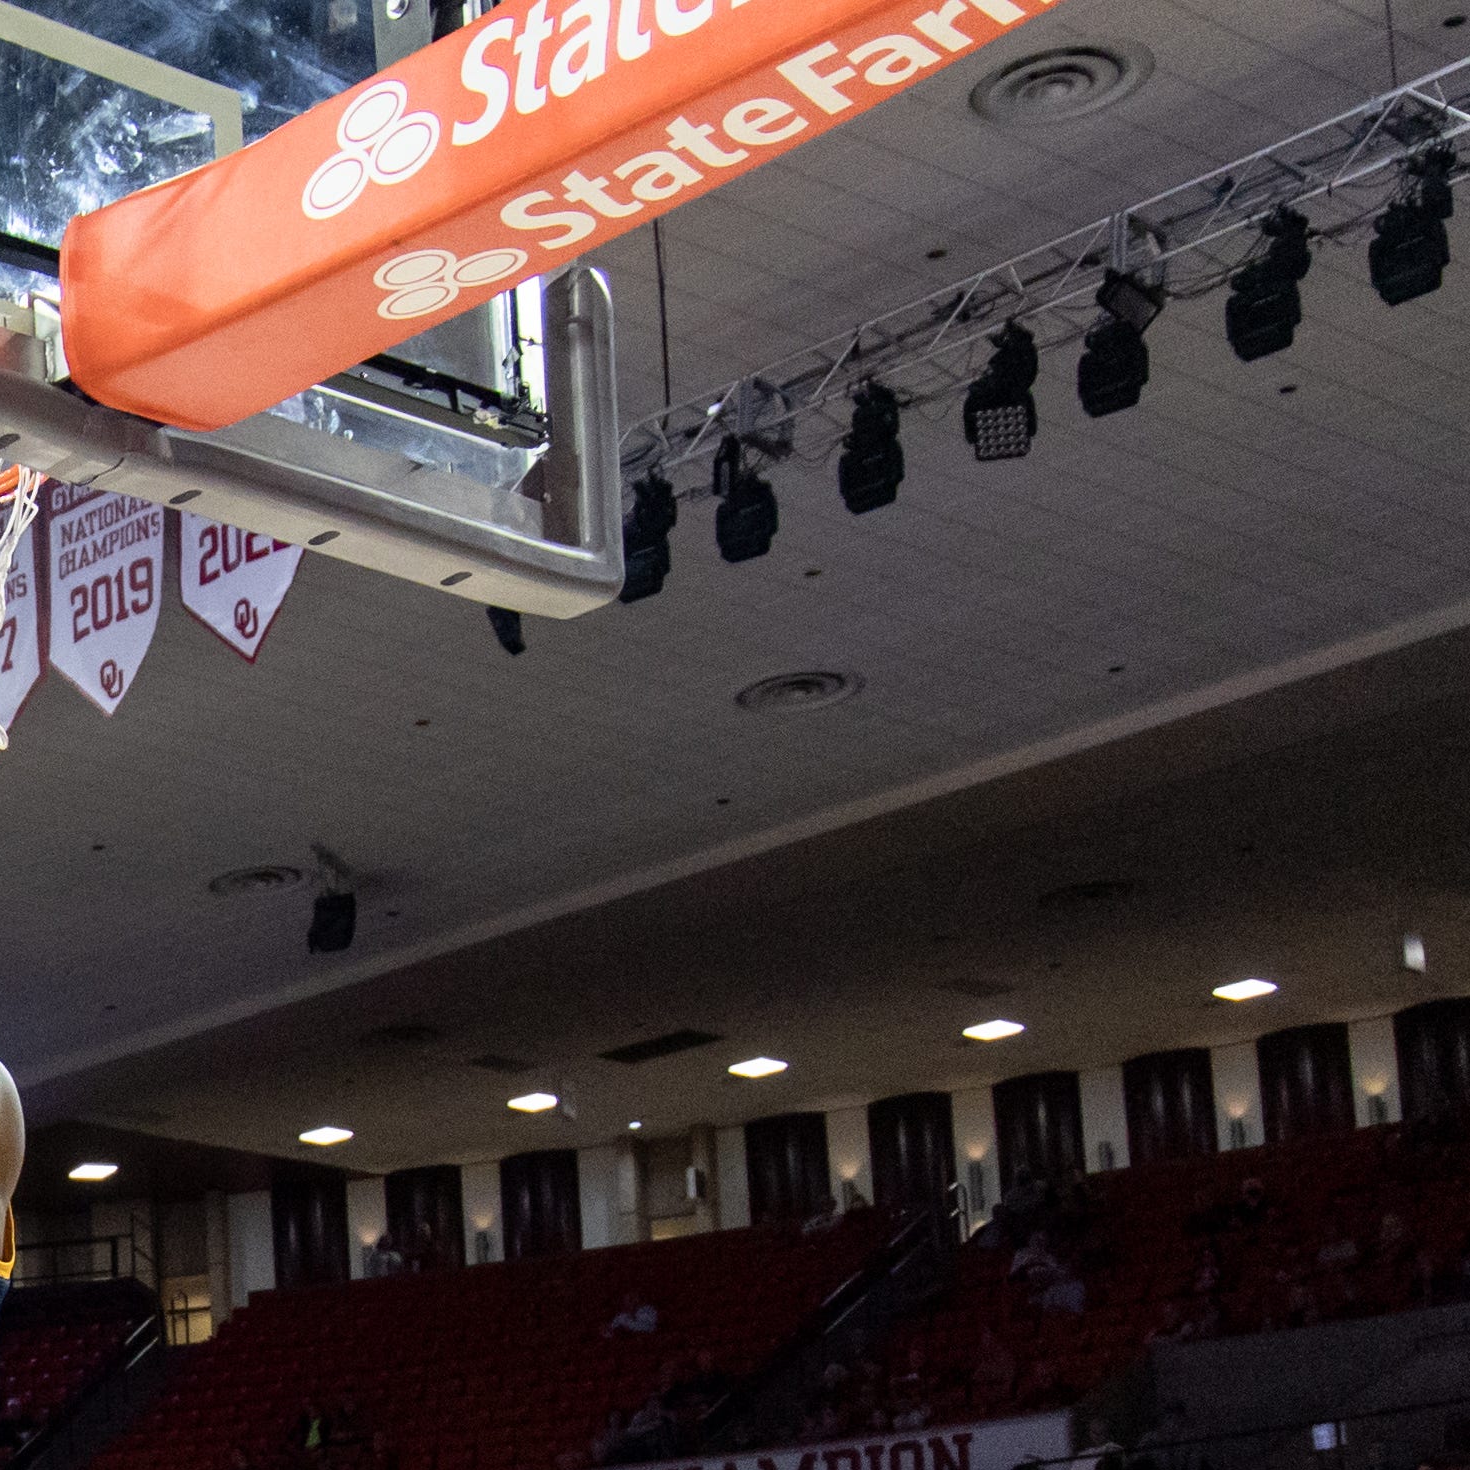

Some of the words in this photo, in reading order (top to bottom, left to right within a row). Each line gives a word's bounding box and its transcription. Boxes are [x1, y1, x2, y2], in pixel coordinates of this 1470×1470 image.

[58, 511, 162, 580] CHAMPIONS
[199, 523, 292, 586] 202
[70, 556, 154, 643] 2019
